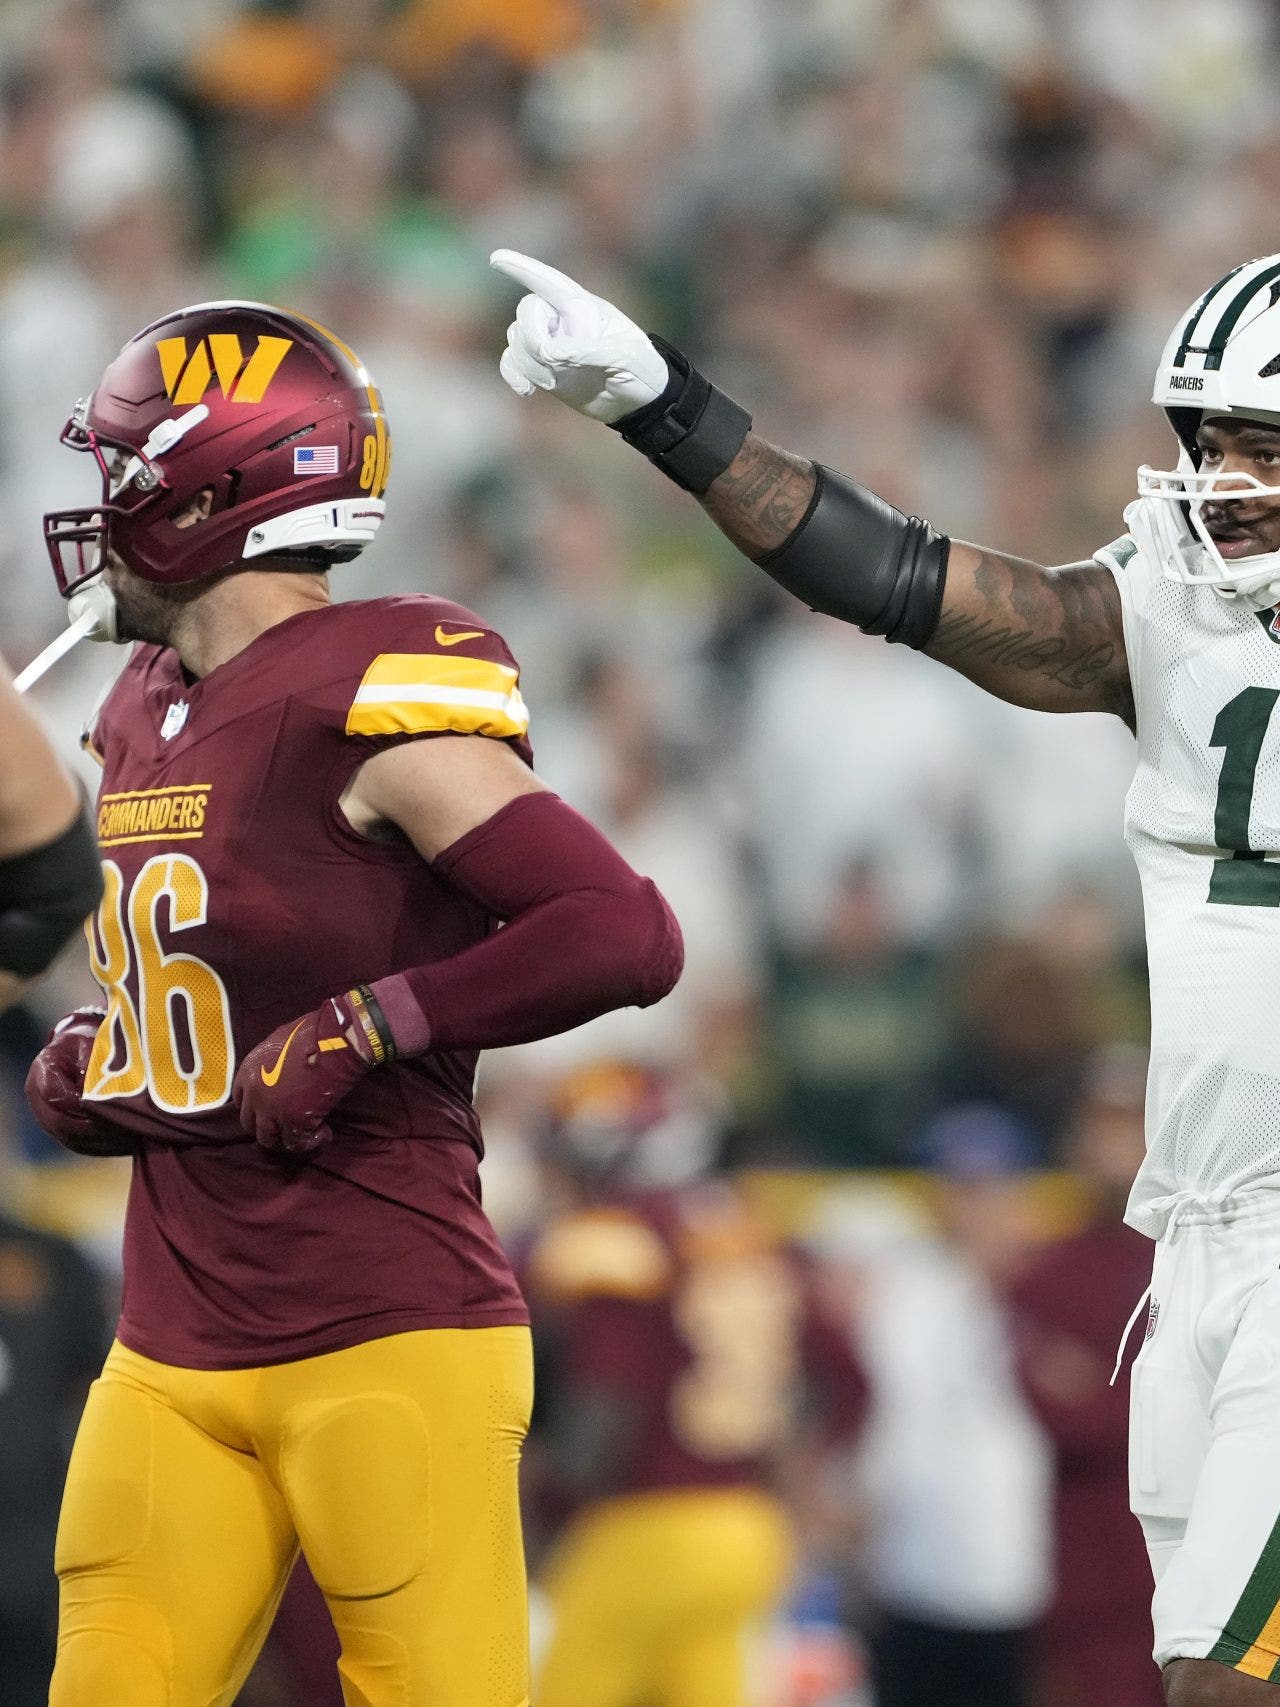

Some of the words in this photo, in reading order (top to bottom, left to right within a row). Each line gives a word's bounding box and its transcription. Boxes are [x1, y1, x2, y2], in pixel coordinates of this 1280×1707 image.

[155, 333, 294, 405] W
[1169, 375, 1204, 391] PACKERS
[98, 794, 208, 838] COMMANDERS
[81, 852, 236, 1115] 86
